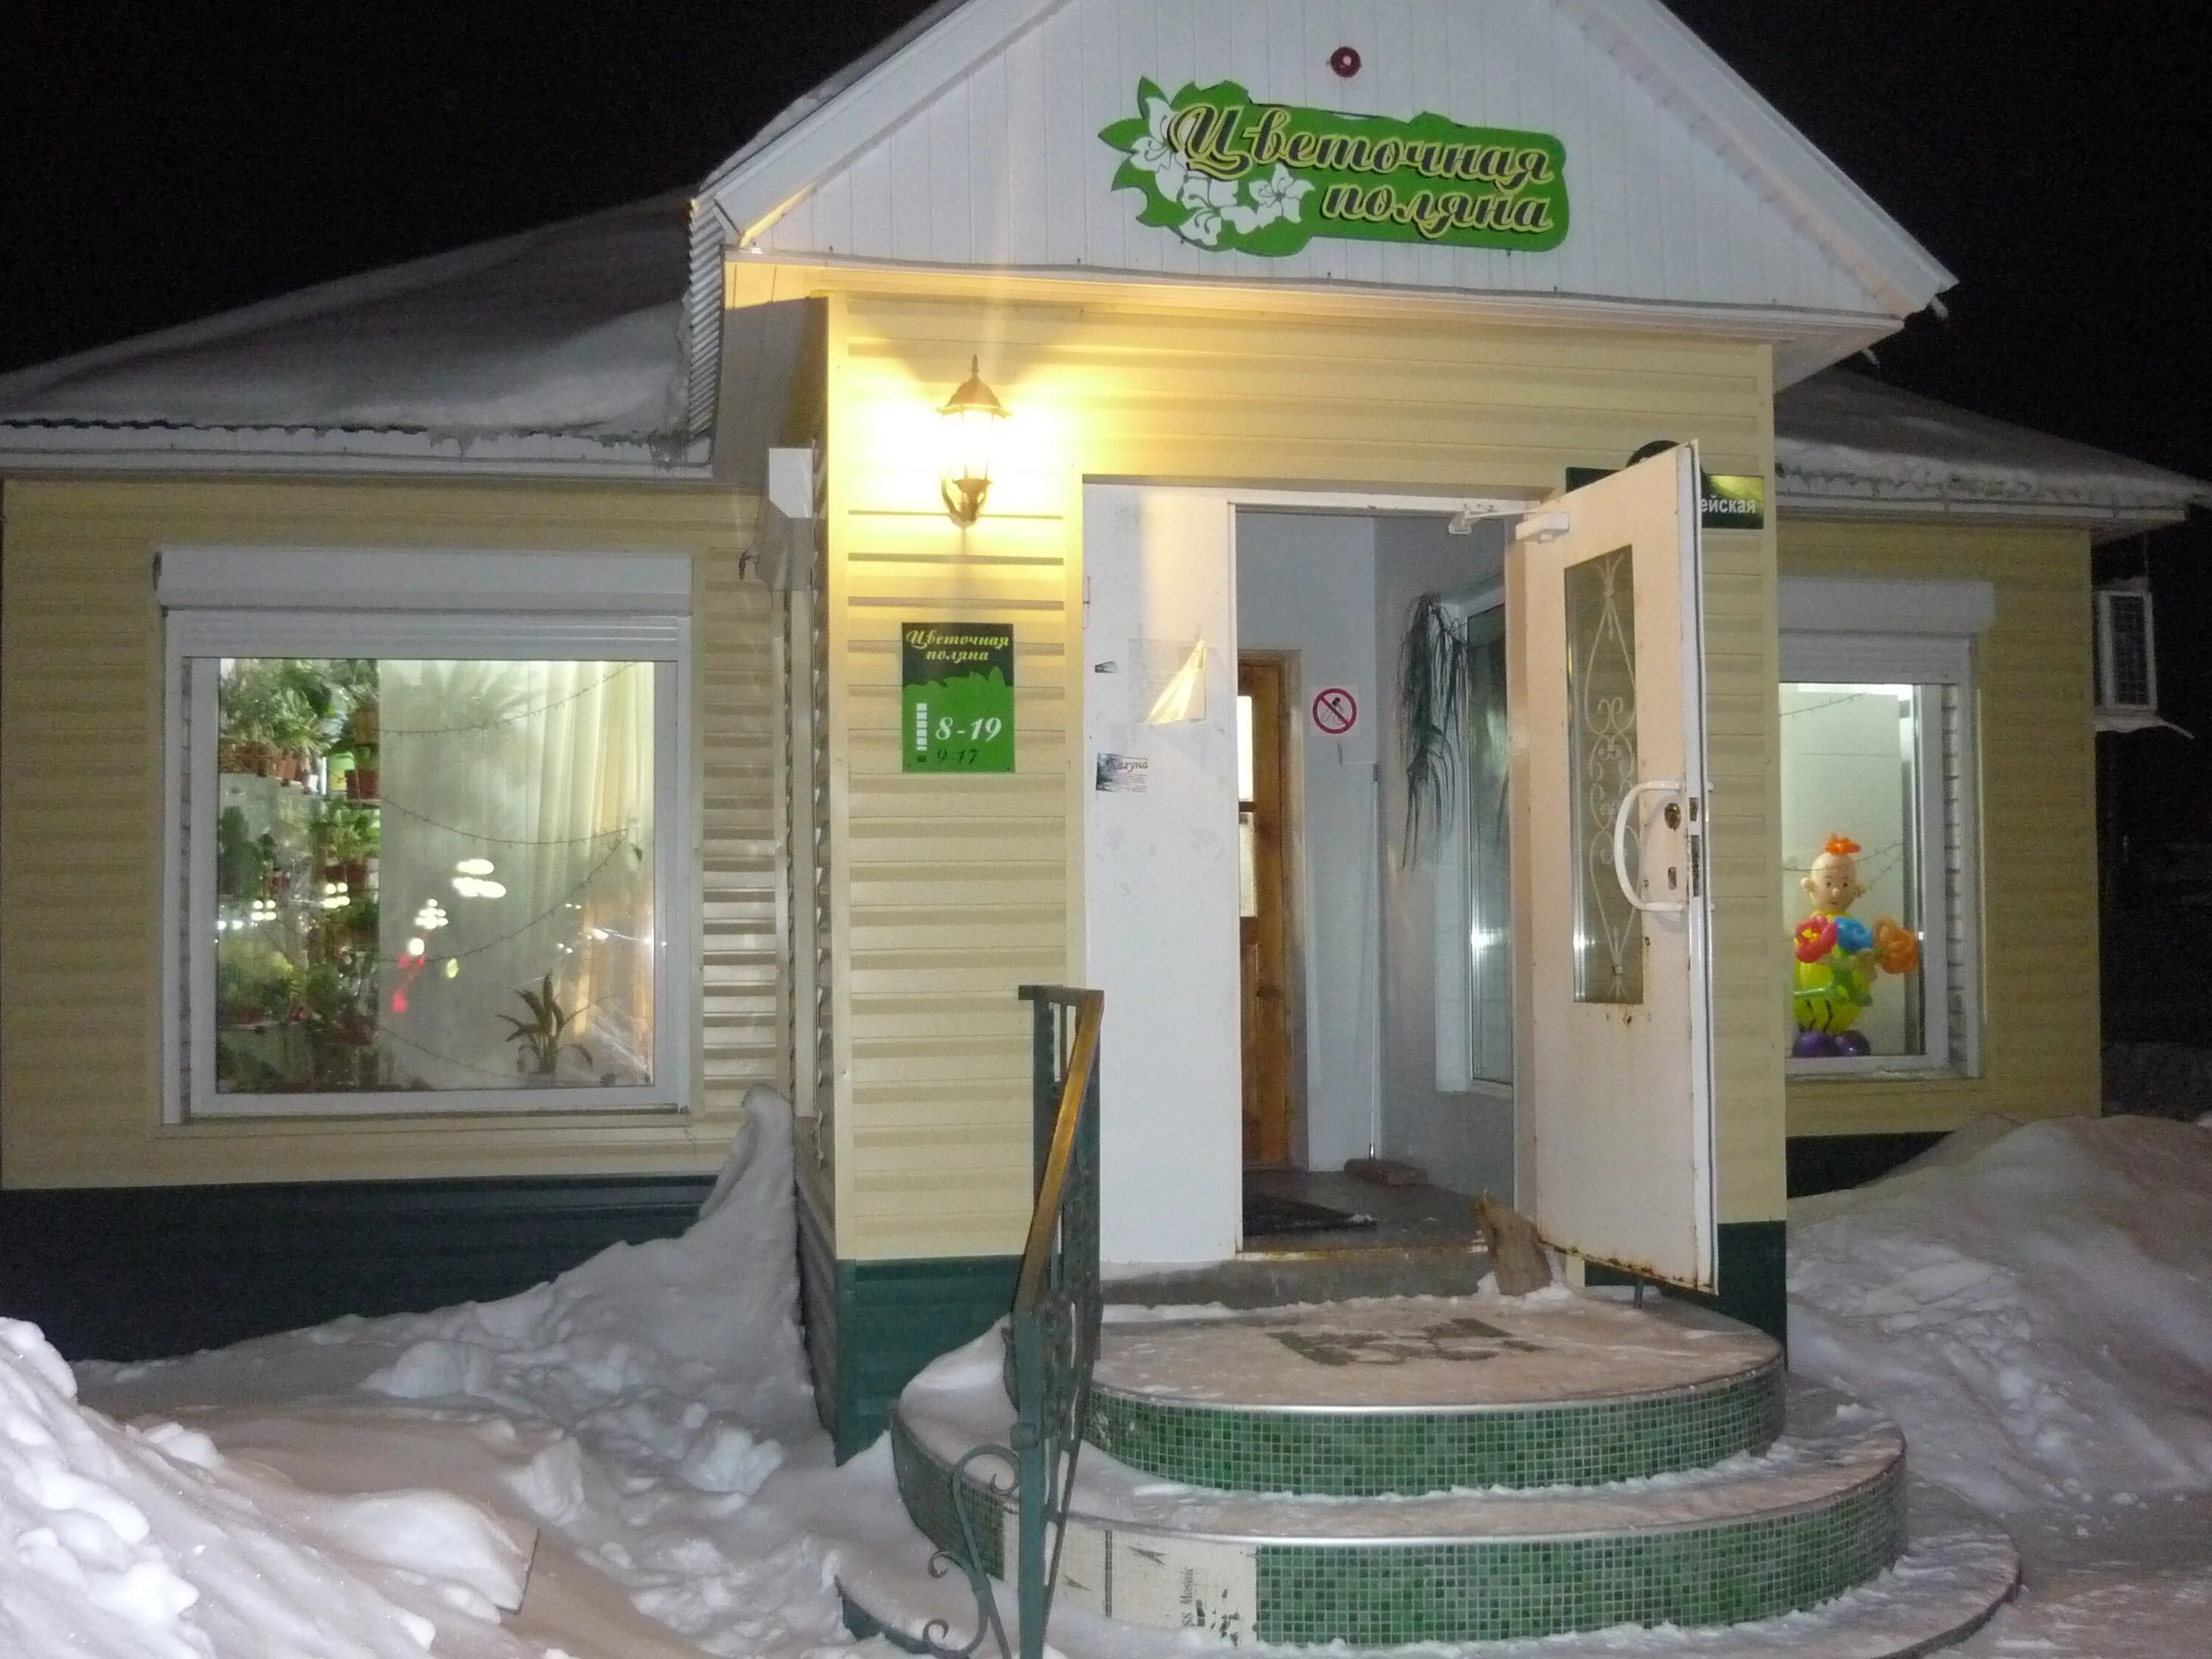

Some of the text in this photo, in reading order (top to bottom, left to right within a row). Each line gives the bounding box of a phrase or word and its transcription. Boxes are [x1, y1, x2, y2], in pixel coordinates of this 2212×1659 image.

[1168, 102, 1554, 194] Цветочная
[1322, 184, 1554, 238] поляна
[1701, 495, 1756, 513] ейская
[906, 630, 1009, 649] Цветочная
[926, 650, 989, 664] поляна
[1180, 1566, 1193, 1604] Mosaic
